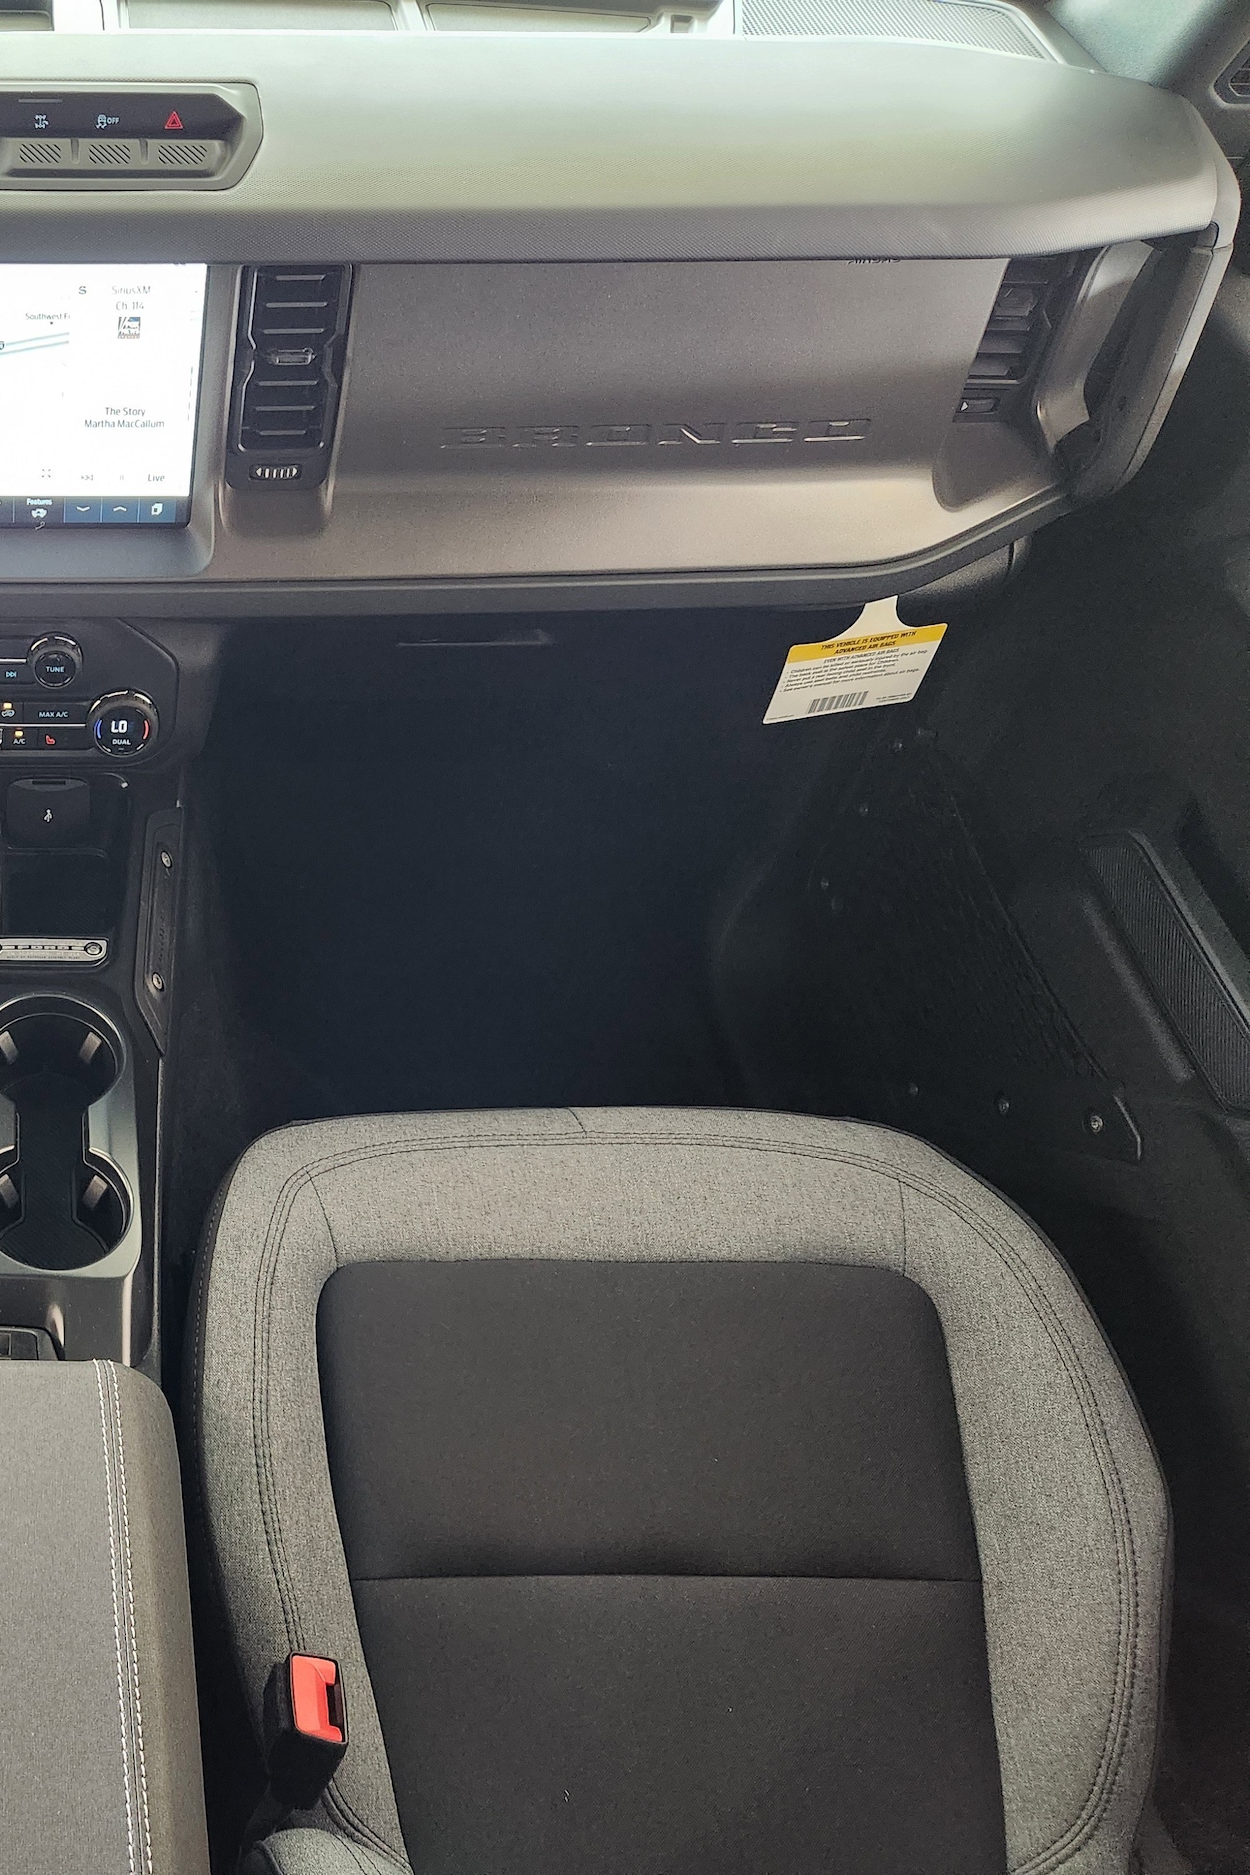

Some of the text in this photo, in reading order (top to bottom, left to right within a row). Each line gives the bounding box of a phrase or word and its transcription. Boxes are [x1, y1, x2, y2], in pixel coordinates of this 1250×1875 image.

[112, 285, 151, 294] SiriusXM
[115, 301, 144, 310] Ch 114
[25, 312, 62, 320] Southwest
[105, 406, 146, 416] The Story
[84, 419, 165, 428] Martha MacCallum
[440, 418, 872, 449] BRONCO
[147, 473, 165, 482] Live
[26, 497, 53, 506] Features
[836, 639, 860, 647] VEHICLE
[868, 633, 899, 642] EQUIPPED
[834, 645, 867, 654] ADVANCED
[112, 738, 131, 746] DUAL
